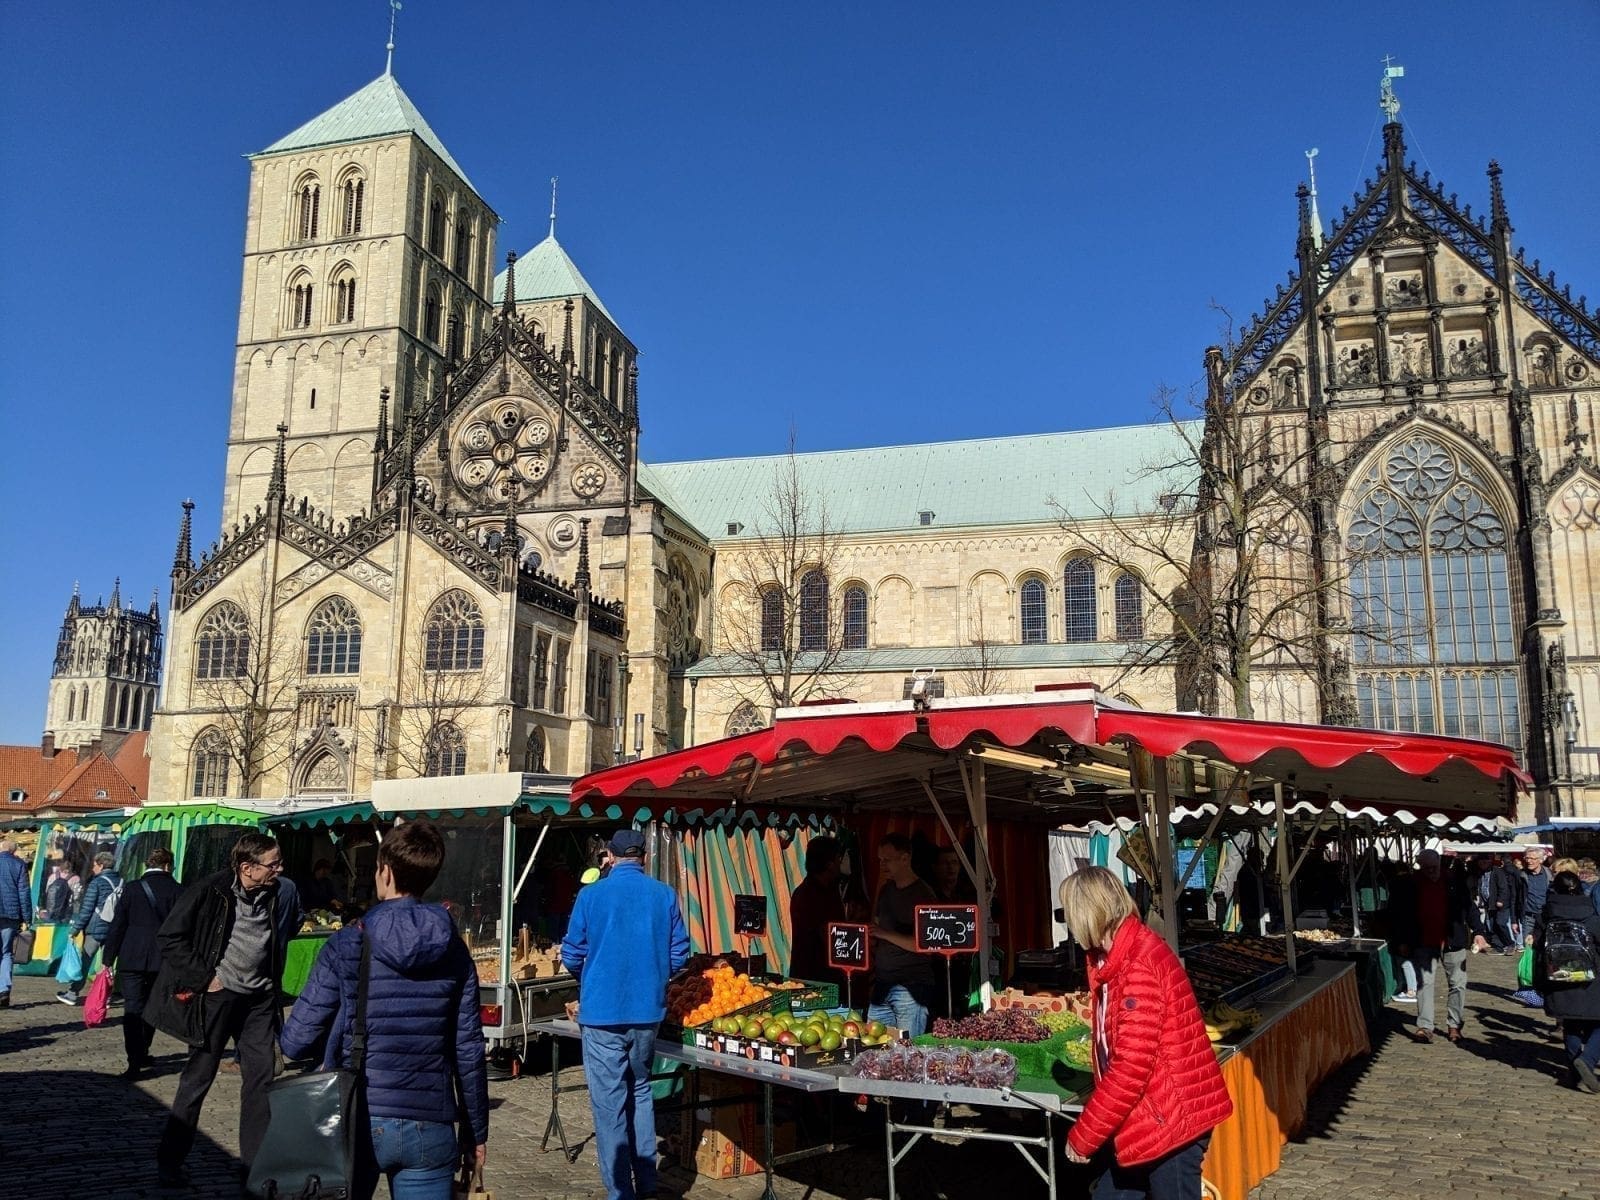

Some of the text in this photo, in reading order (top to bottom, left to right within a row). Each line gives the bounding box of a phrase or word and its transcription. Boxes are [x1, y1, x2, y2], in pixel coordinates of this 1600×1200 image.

[831, 926, 848, 939] Mango
[925, 926, 952, 946] 500g
[721, 1142, 734, 1177] Dole
